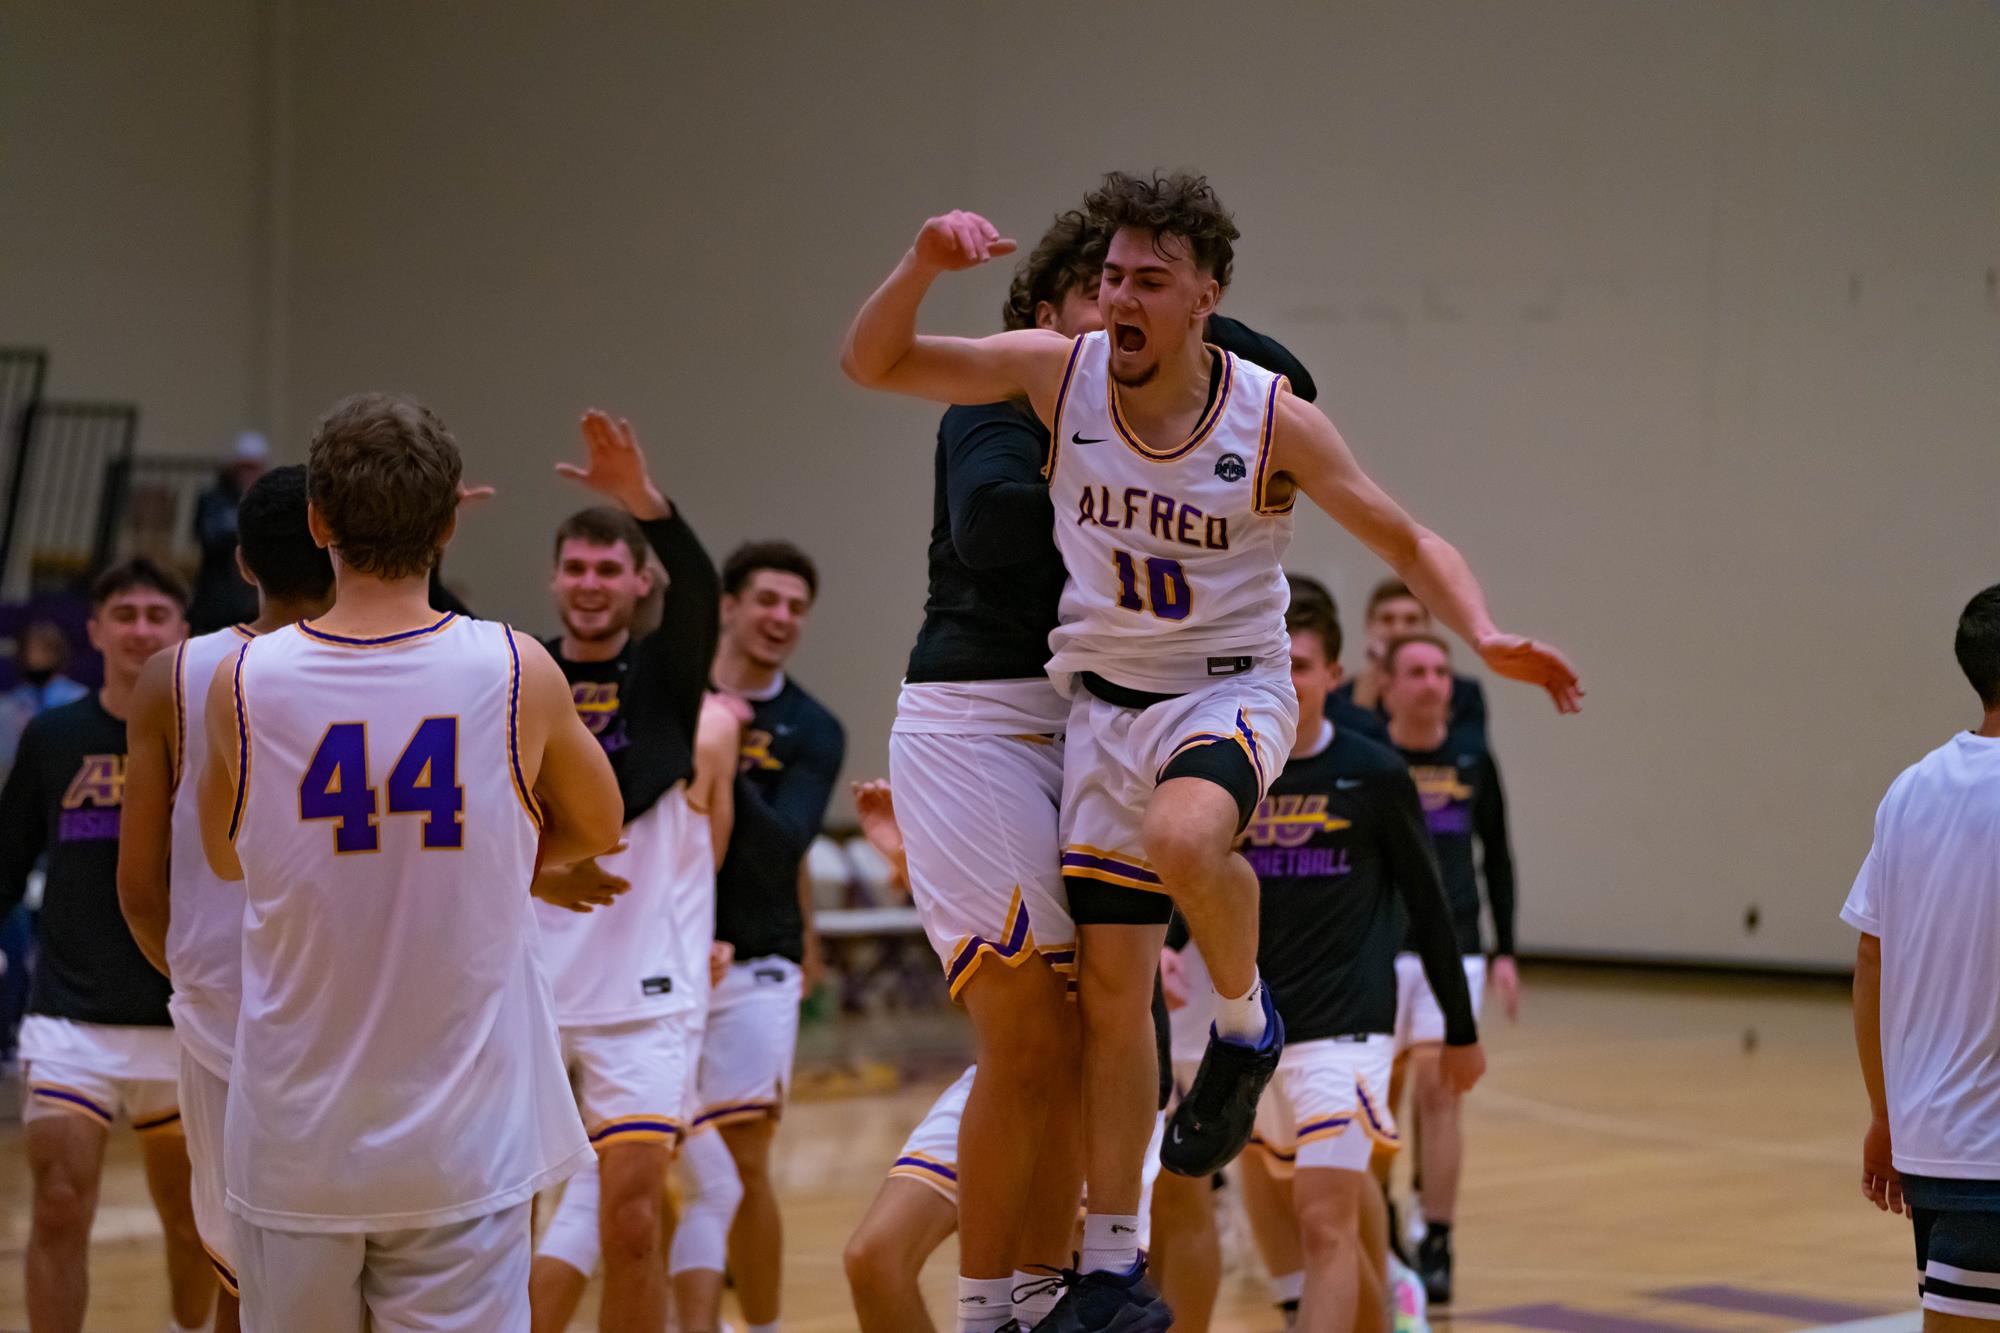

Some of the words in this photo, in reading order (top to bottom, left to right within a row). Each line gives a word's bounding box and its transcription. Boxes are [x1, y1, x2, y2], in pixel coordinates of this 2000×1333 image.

[1077, 485, 1229, 550] ALFRED
[1111, 547, 1194, 622] 10
[298, 714, 465, 856] 44
